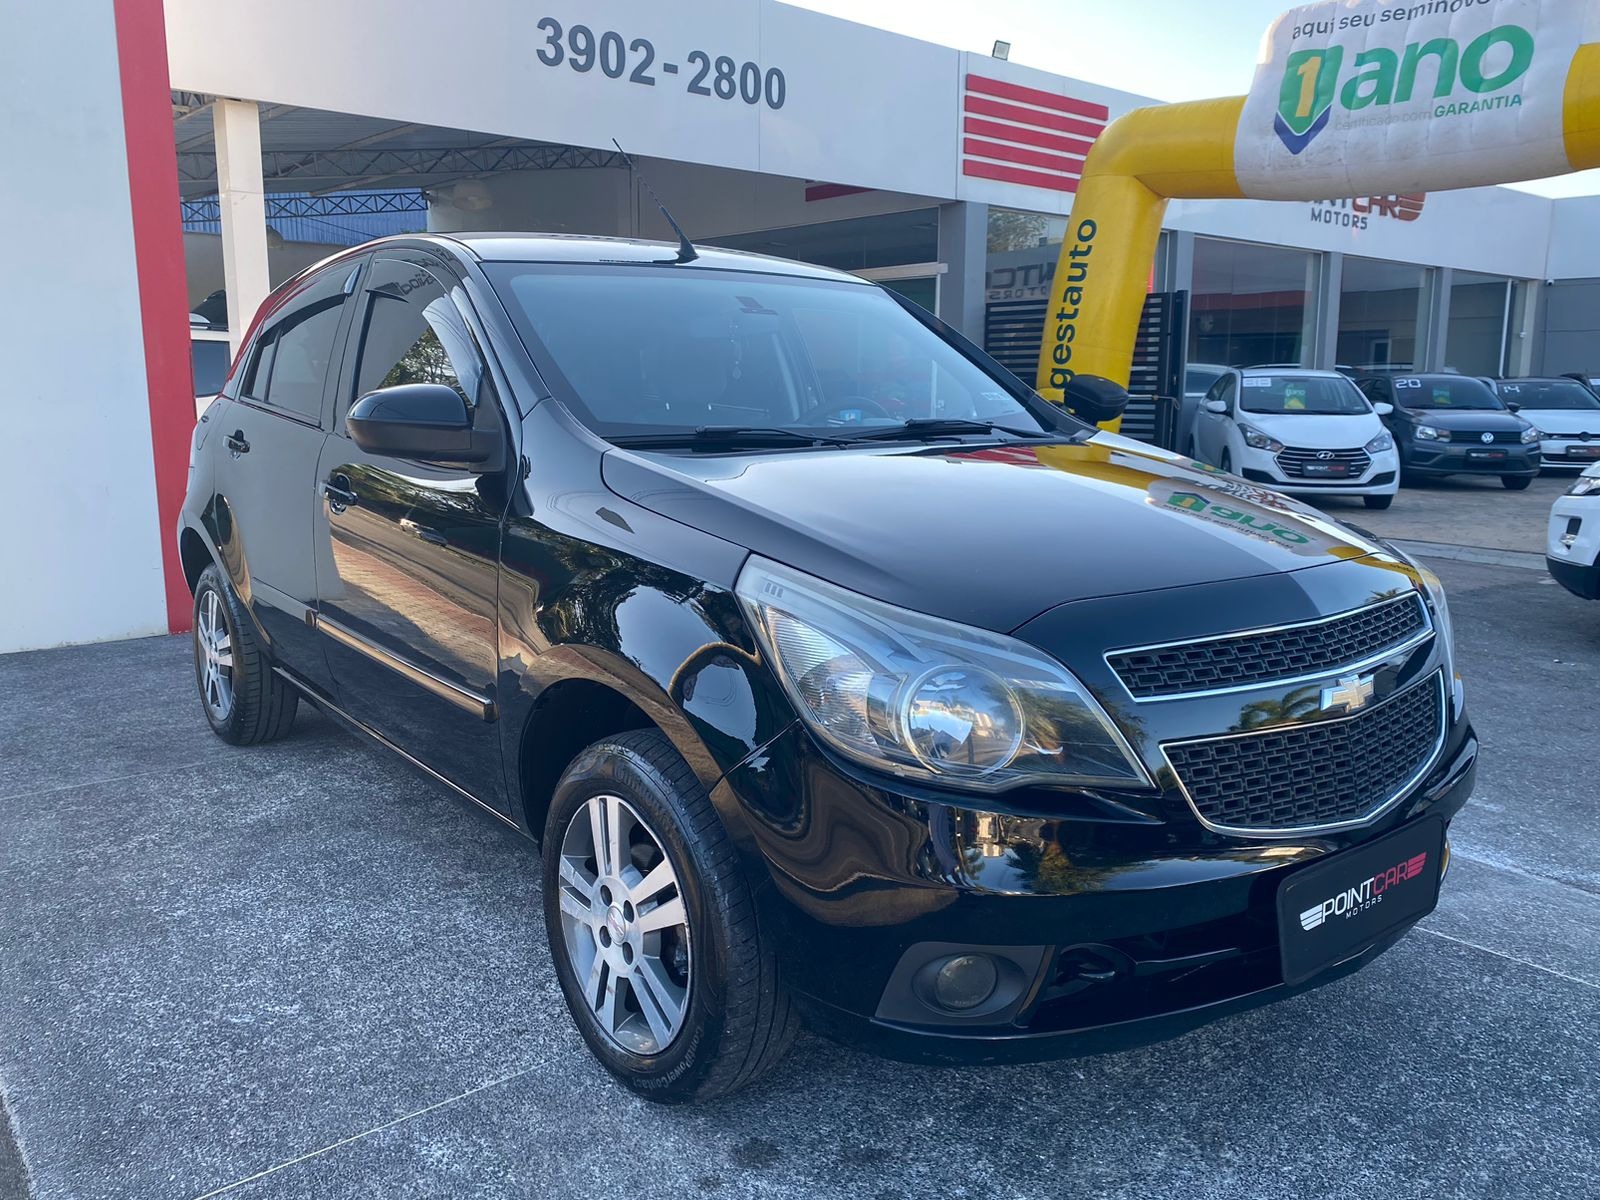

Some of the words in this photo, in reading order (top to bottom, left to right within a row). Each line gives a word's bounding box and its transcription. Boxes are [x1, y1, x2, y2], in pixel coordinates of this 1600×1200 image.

[1292, 17, 1335, 40] aqui
[1338, 12, 1375, 30] seu
[536, 17, 786, 110] 3902-2800
[1340, 25, 1535, 111] ano
[1434, 94, 1522, 118] GARANTIA
[1311, 207, 1368, 230] MOTORS
[1050, 219, 1097, 390] gestauto
[1395, 378, 1422, 389] 20
[1322, 861, 1408, 924] POINTCAR
[1345, 894, 1383, 920] MOTORS
